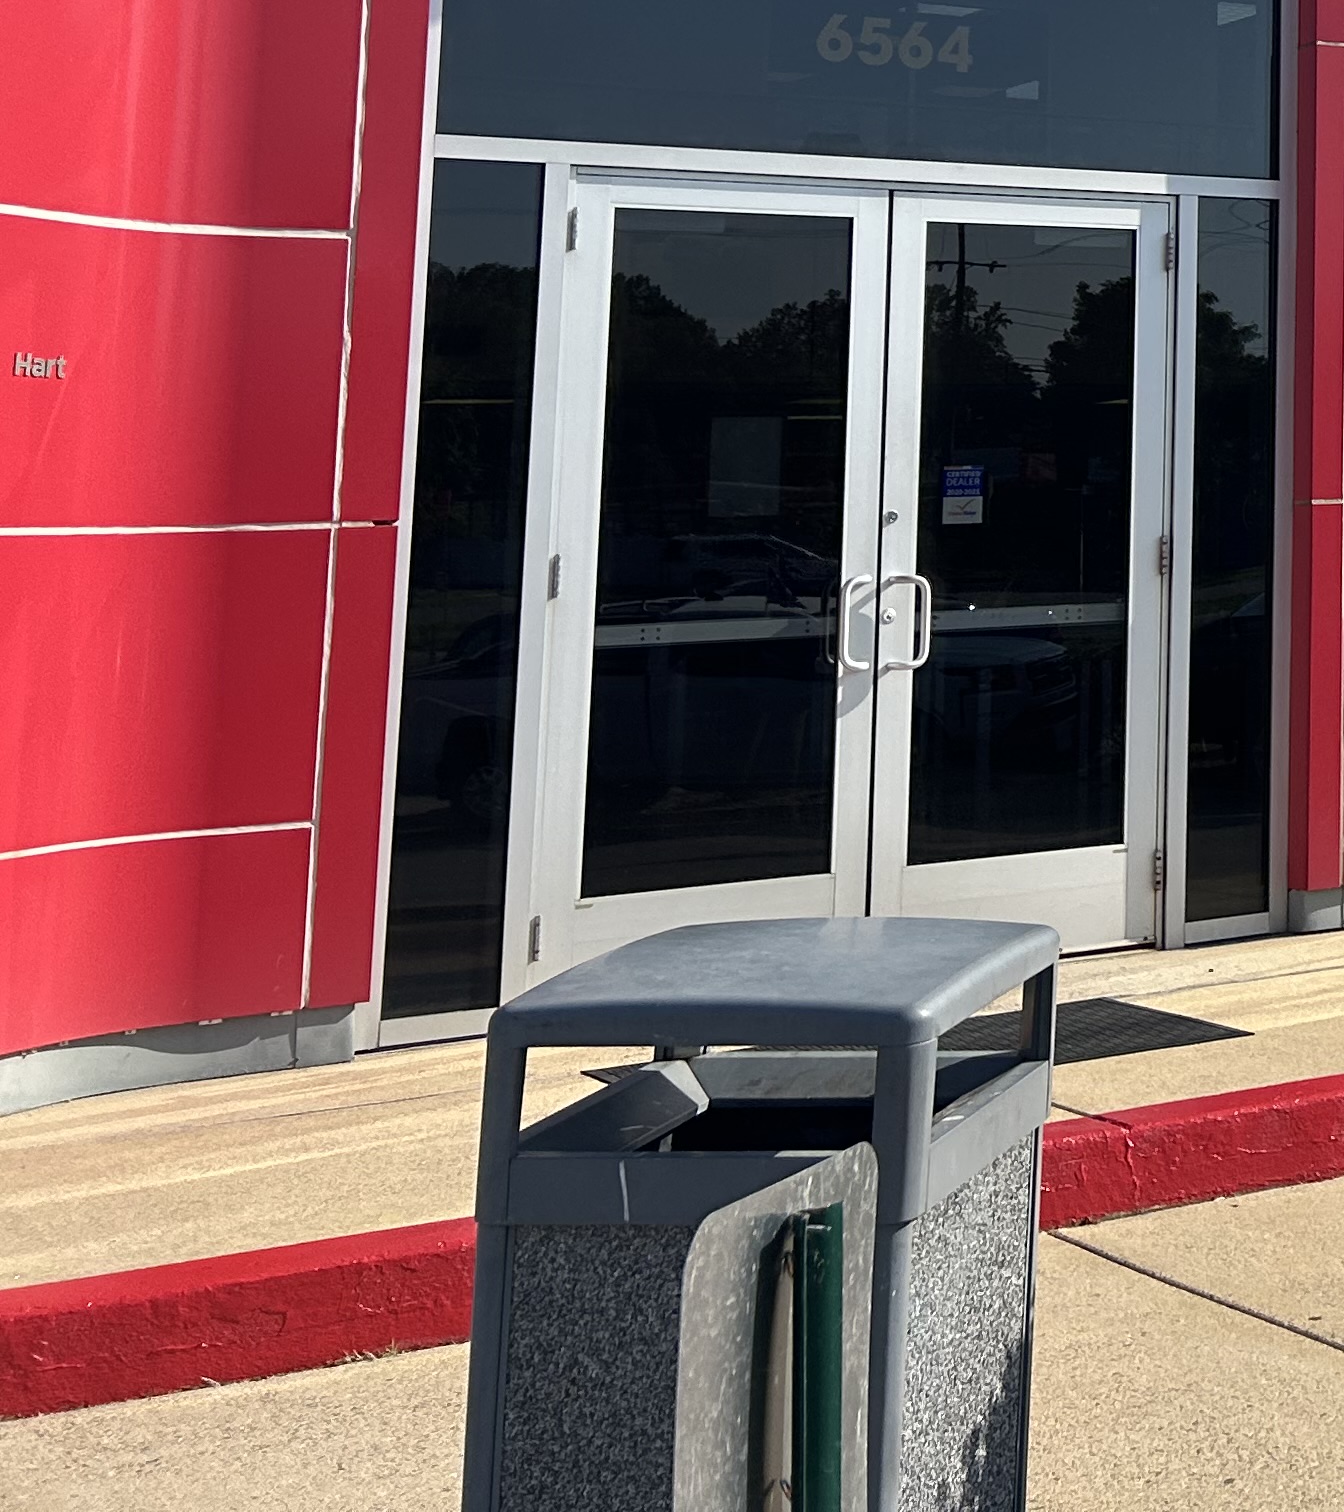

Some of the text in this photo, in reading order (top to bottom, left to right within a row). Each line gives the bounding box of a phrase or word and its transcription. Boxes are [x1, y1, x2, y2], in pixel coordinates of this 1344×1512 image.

[816, 13, 973, 72] 6564
[13, 352, 66, 379] Hart
[946, 478, 980, 486] DEALER
